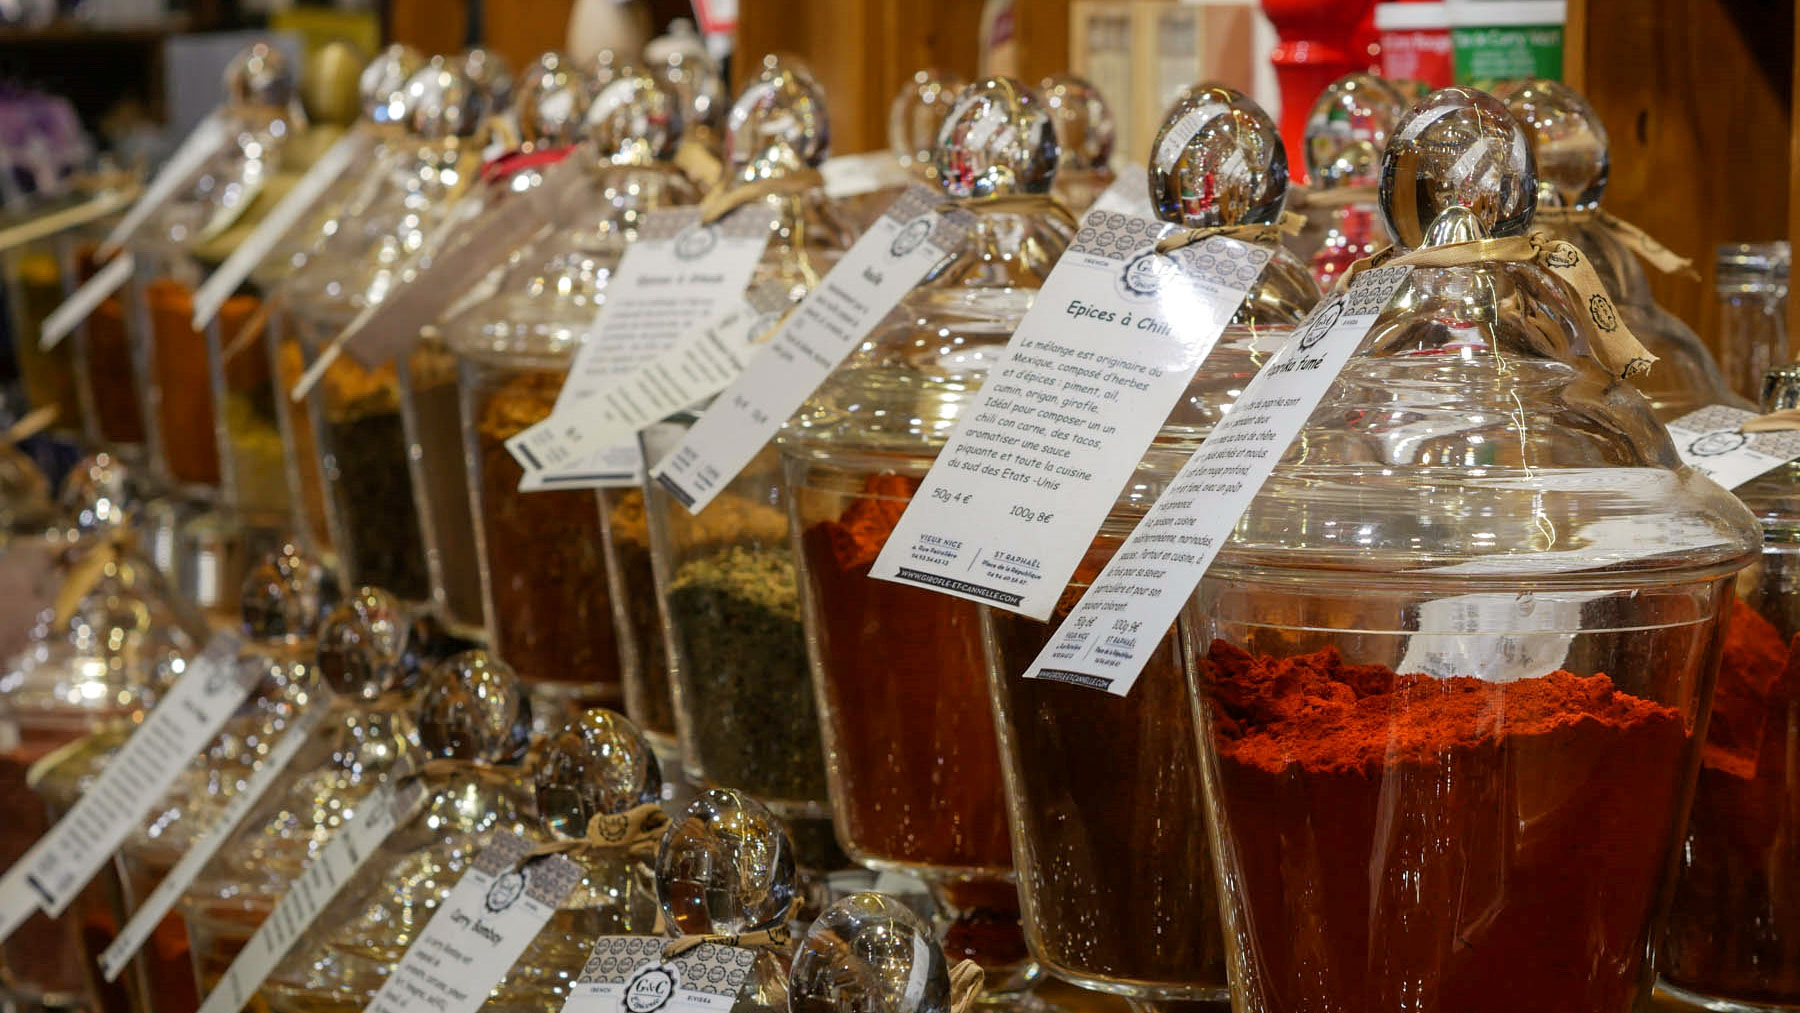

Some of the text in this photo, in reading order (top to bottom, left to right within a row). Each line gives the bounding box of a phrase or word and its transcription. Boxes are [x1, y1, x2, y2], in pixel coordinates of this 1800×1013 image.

[1066, 300, 1116, 322] Epices
[1120, 311, 1131, 325] à
[1019, 337, 1162, 377] Le mélange est originaire du
[1296, 352, 1328, 371] fumé
[1002, 369, 1014, 377] et
[1015, 369, 1056, 385] d'épices
[1061, 380, 1099, 397] piment,
[1103, 390, 1119, 402] ail,
[1056, 363, 1102, 379] composé
[1102, 372, 1149, 391] d'herbes
[992, 384, 1022, 396] cumin,
[1025, 390, 1058, 404] origan,
[983, 396, 1115, 434] Idéal pour composer un un
[974, 412, 1101, 449] chili con carne, des tacos,
[965, 429, 1070, 458] aromatiser une sauce
[947, 457, 1060, 490] du sud des Etats -Unis
[954, 443, 1091, 480] piquante et toute la cuisine
[931, 487, 972, 504] 50g 4 €
[1009, 505, 1054, 523] 100g 8€
[920, 534, 962, 548] VIEUX NICE
[993, 550, 1040, 568] ST RAPHAËL
[1010, 566, 1041, 579] République
[635, 978, 667, 996] G&C
